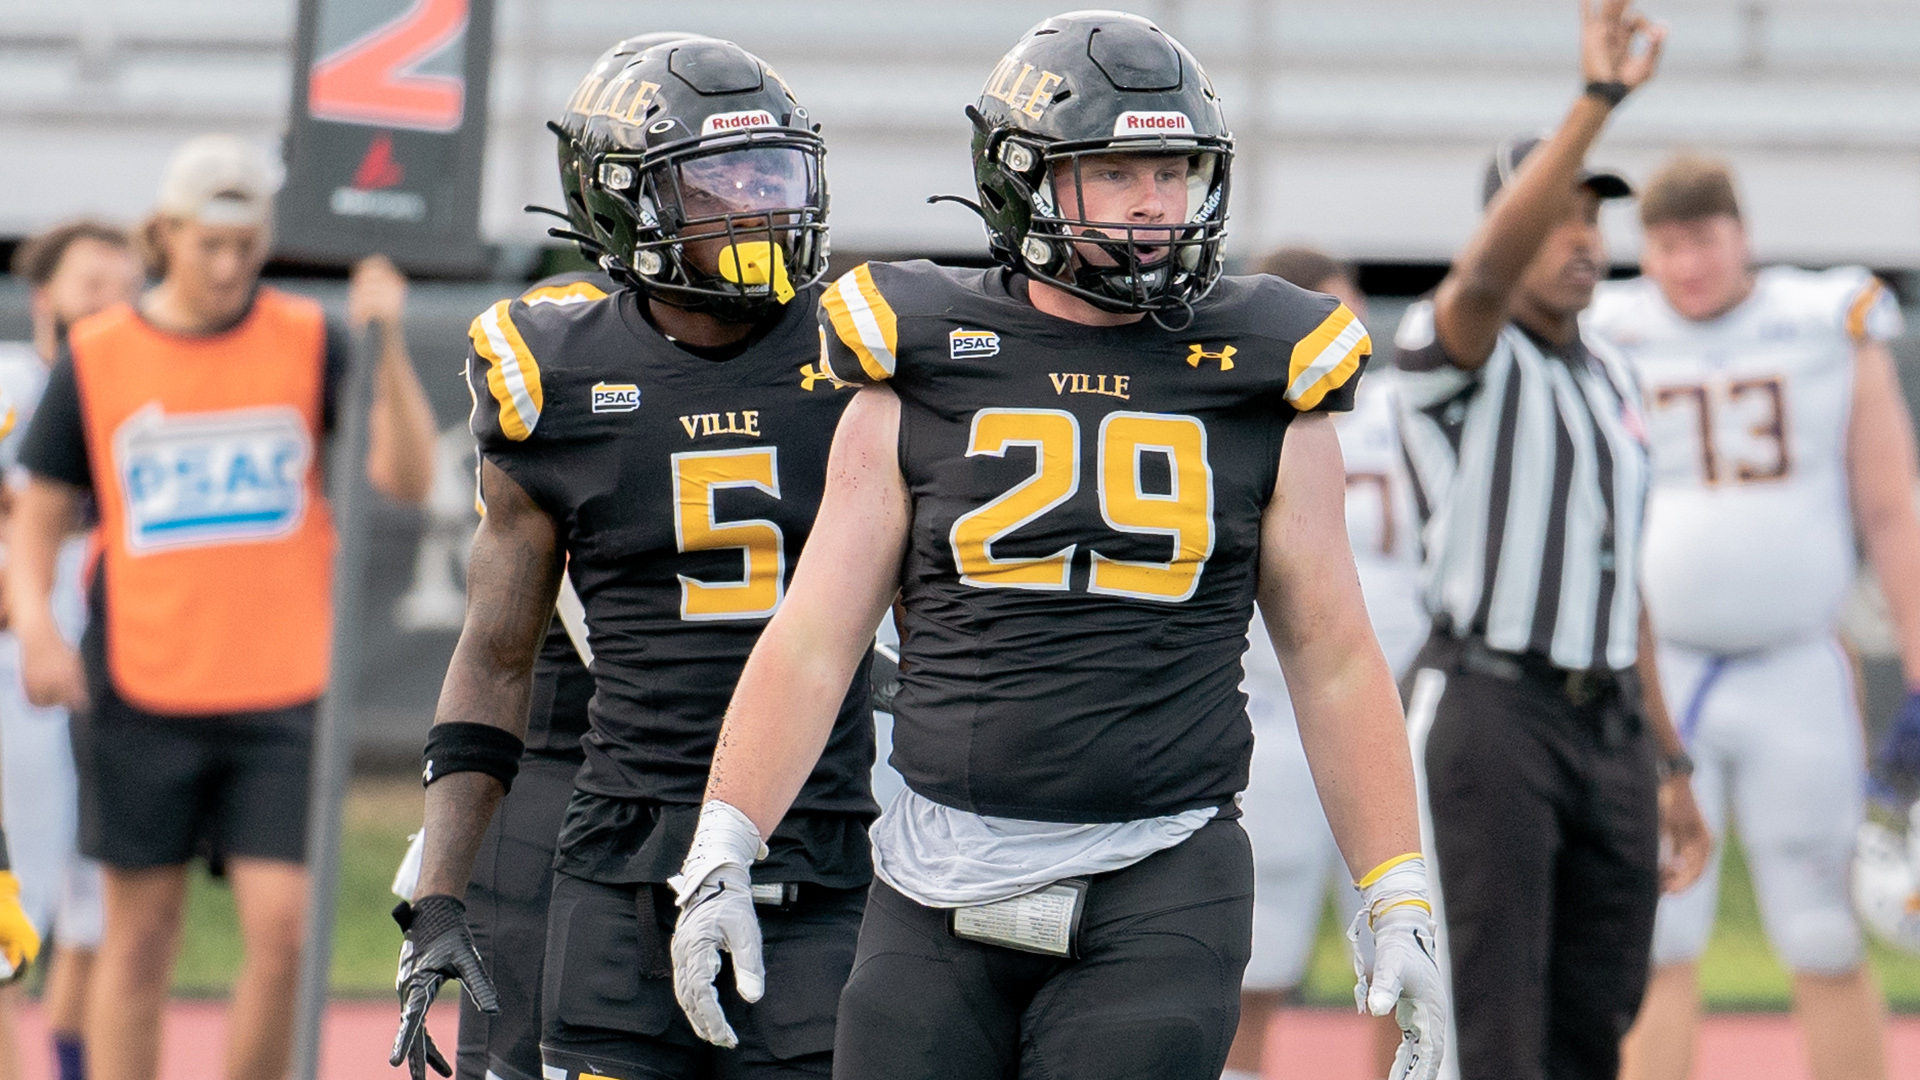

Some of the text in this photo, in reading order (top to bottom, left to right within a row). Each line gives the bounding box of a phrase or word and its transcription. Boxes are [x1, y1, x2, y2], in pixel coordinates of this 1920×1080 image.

[308, 0, 470, 132] 2
[712, 114, 770, 130] Riddell
[1127, 115, 1185, 129] Riddell
[953, 337, 996, 350] PSAC
[595, 391, 636, 404] PSAC
[1049, 373, 1130, 400] VILLE
[679, 410, 761, 439] VILLE
[1655, 374, 1790, 486] 73
[949, 407, 1216, 603] 29
[671, 446, 785, 621] 5
